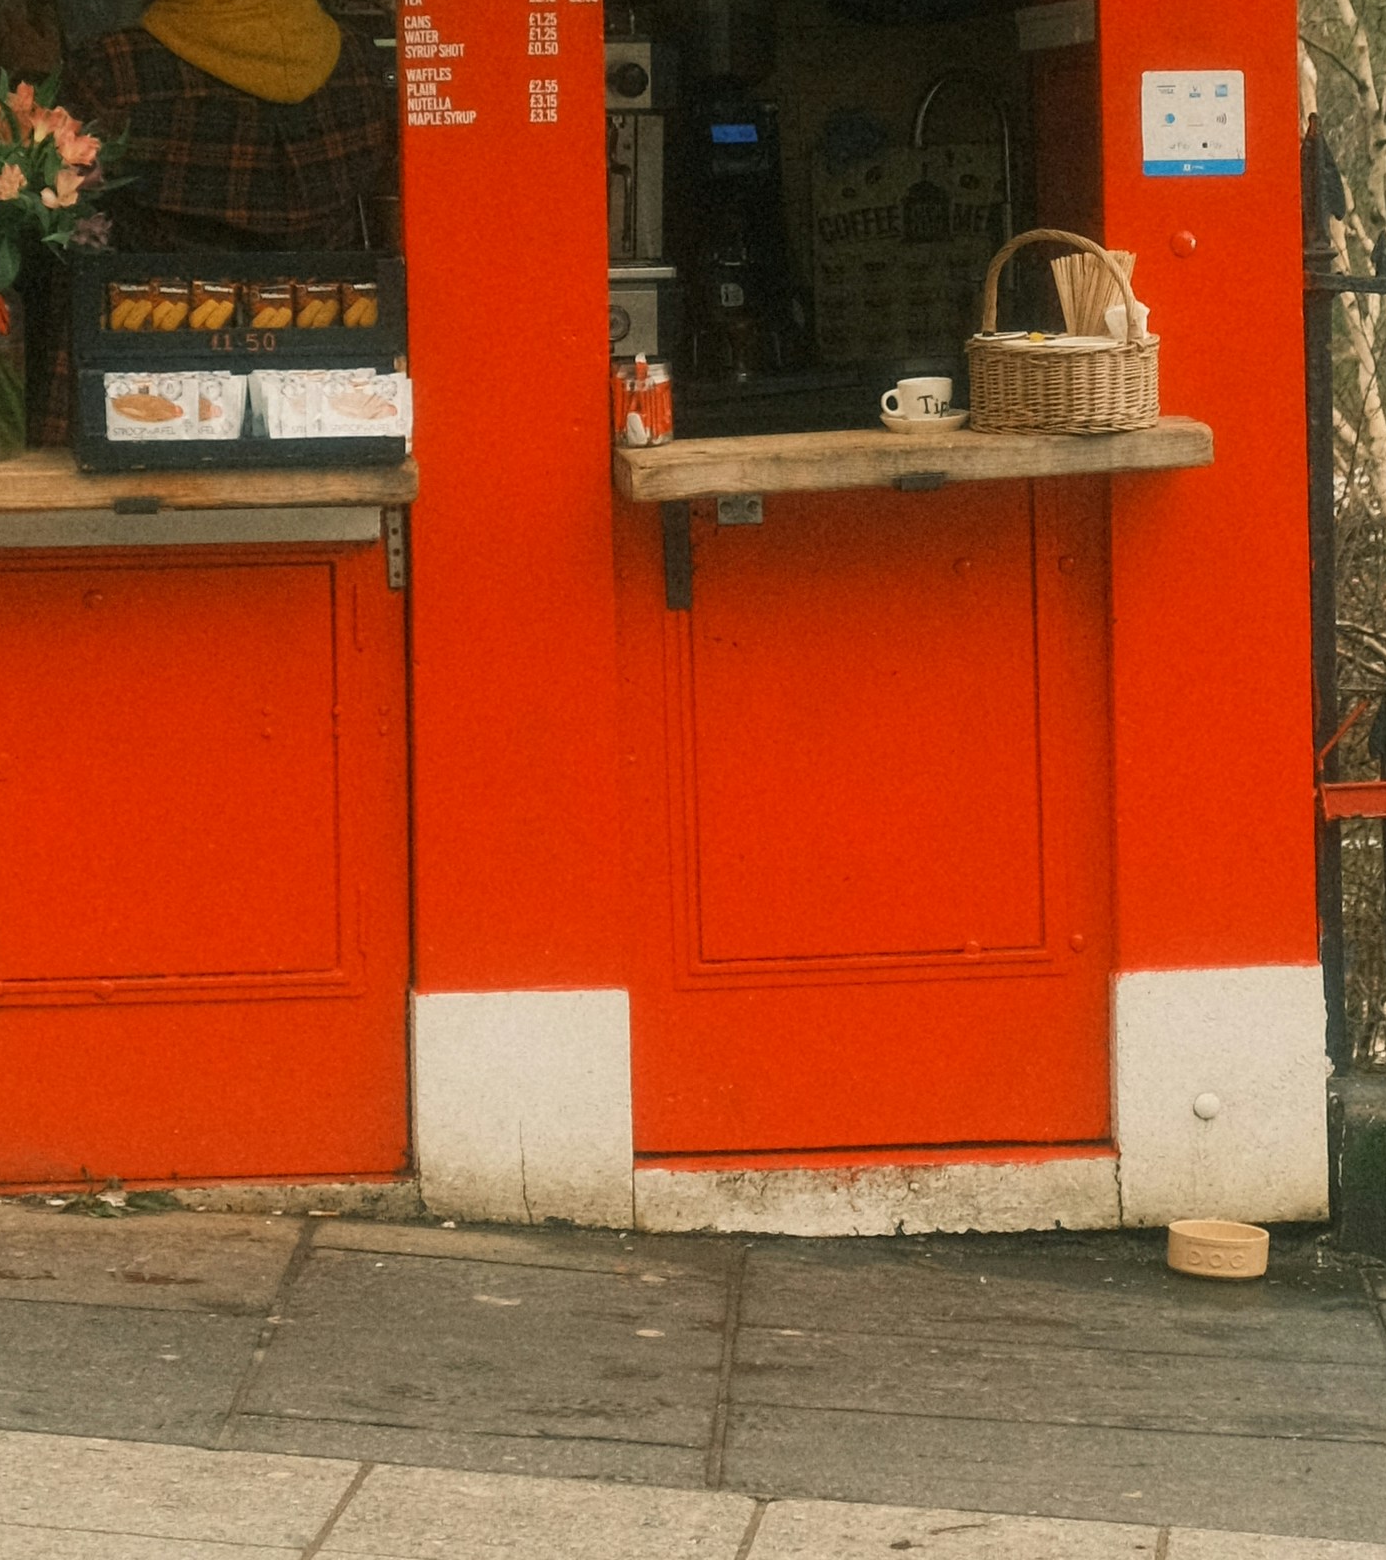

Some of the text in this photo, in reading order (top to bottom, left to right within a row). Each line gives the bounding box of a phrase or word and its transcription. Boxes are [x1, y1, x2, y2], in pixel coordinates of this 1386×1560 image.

[404, 13, 557, 29] CANS £1.25
[405, 28, 557, 43] WATER £1.25
[405, 45, 438, 59] SYRUP
[439, 43, 464, 57] SHOT
[406, 68, 452, 81] WAFFLES
[407, 80, 558, 96] PLAIN £2.55
[408, 95, 557, 111] NUTELLA £3.15
[408, 109, 557, 126] MAPLE SYRUP £3.15
[1185, 1250, 1246, 1270] DOG
